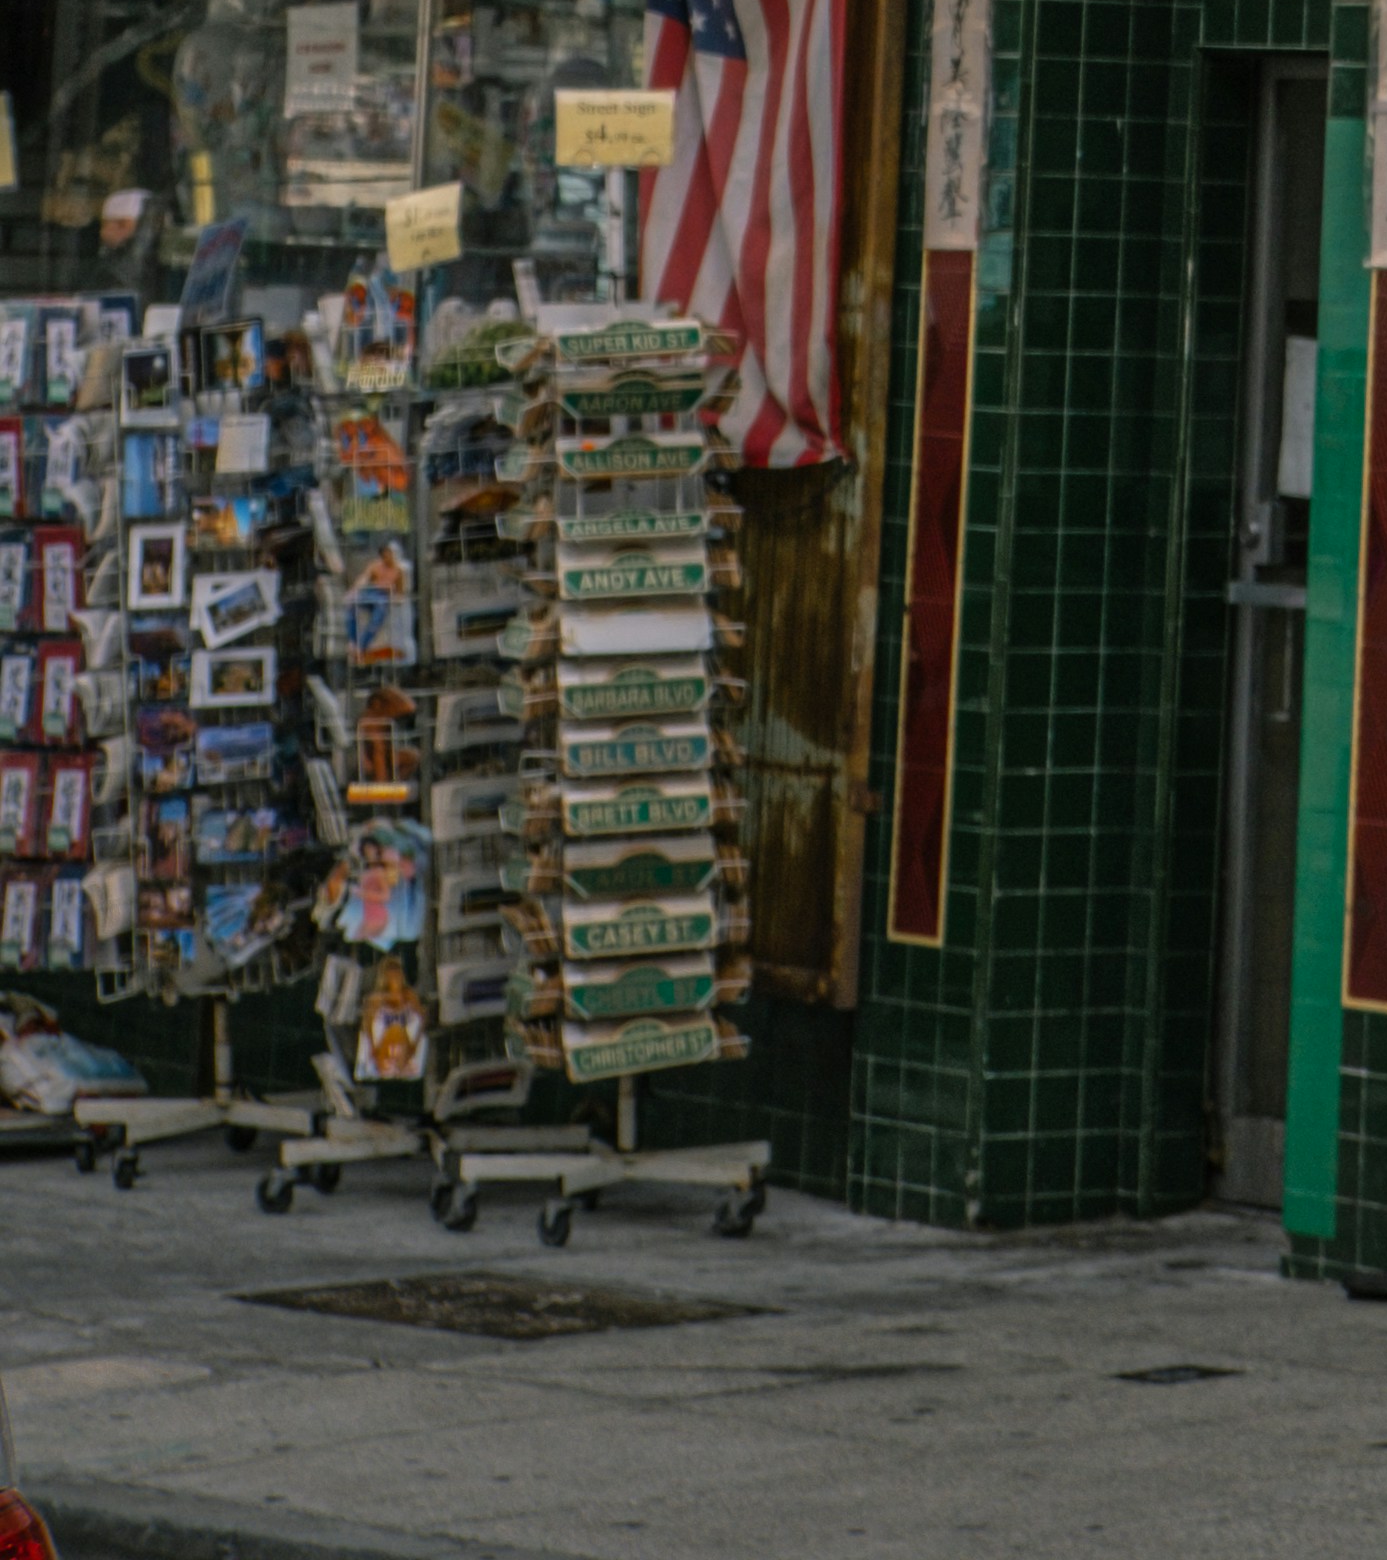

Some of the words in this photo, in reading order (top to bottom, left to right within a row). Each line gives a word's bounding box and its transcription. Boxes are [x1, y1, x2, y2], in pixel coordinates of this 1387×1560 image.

[576, 101, 618, 116] Street
[622, 101, 656, 118] Sign
[567, 334, 628, 355] SUPER
[632, 332, 661, 350] KID
[579, 572, 642, 592] ANDY
